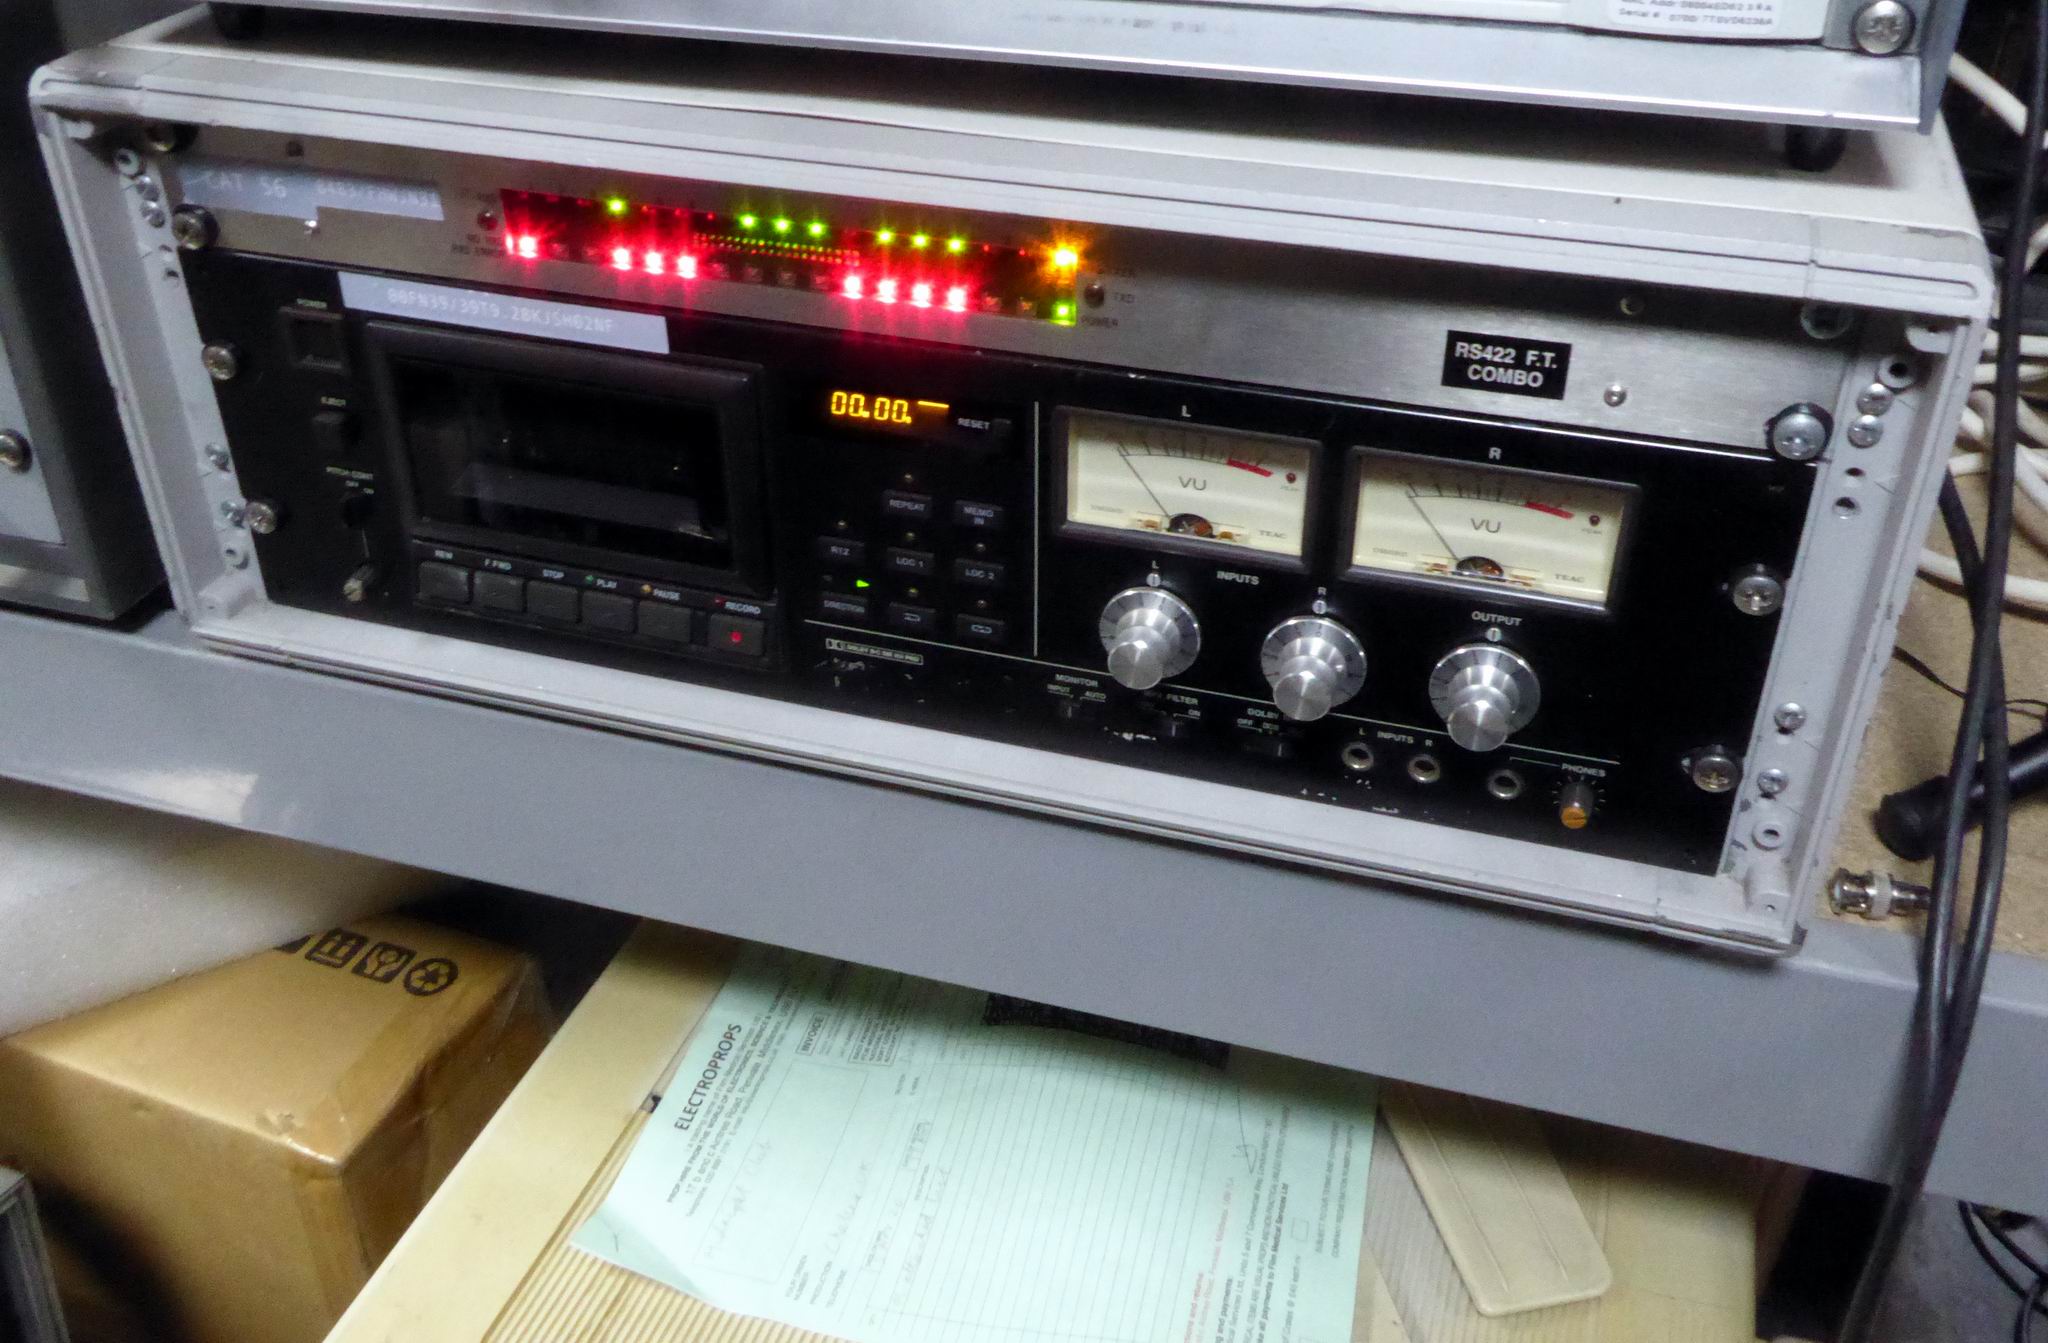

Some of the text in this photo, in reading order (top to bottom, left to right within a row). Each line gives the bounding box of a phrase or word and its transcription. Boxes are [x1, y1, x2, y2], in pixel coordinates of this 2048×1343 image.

[1454, 341, 1558, 369] RS422 F.T.
[1467, 364, 1544, 388] COMBO
[1181, 405, 1191, 418] L
[957, 417, 991, 431] RESET
[1488, 447, 1502, 460] R
[1178, 475, 1207, 491] VU
[1471, 517, 1501, 534] VU
[1258, 529, 1287, 540] TEAC
[1151, 560, 1160, 570] L
[597, 578, 618, 590] PLAY
[1216, 569, 1261, 586] INPUTS
[1555, 573, 1585, 584] TEAC
[653, 586, 681, 601] PAUSE
[1317, 586, 1326, 596] R
[725, 601, 762, 616] RECORD
[1471, 610, 1523, 627] OUTPUT
[1055, 673, 1098, 688] MONITOR
[1377, 731, 1414, 744] INPUTS
[1561, 762, 1606, 778] PHONES
[800, 1016, 824, 1051] INVOICE
[674, 1023, 741, 1130] ELECTROPROPS
[1279, 1182, 1289, 1194] Ltd
[1276, 1195, 1287, 1224] Services
[1271, 1225, 1283, 1252] Medical
[1268, 1253, 1277, 1269] Film
[1260, 1281, 1275, 1319] payments
[1216, 1317, 1225, 1333] and
